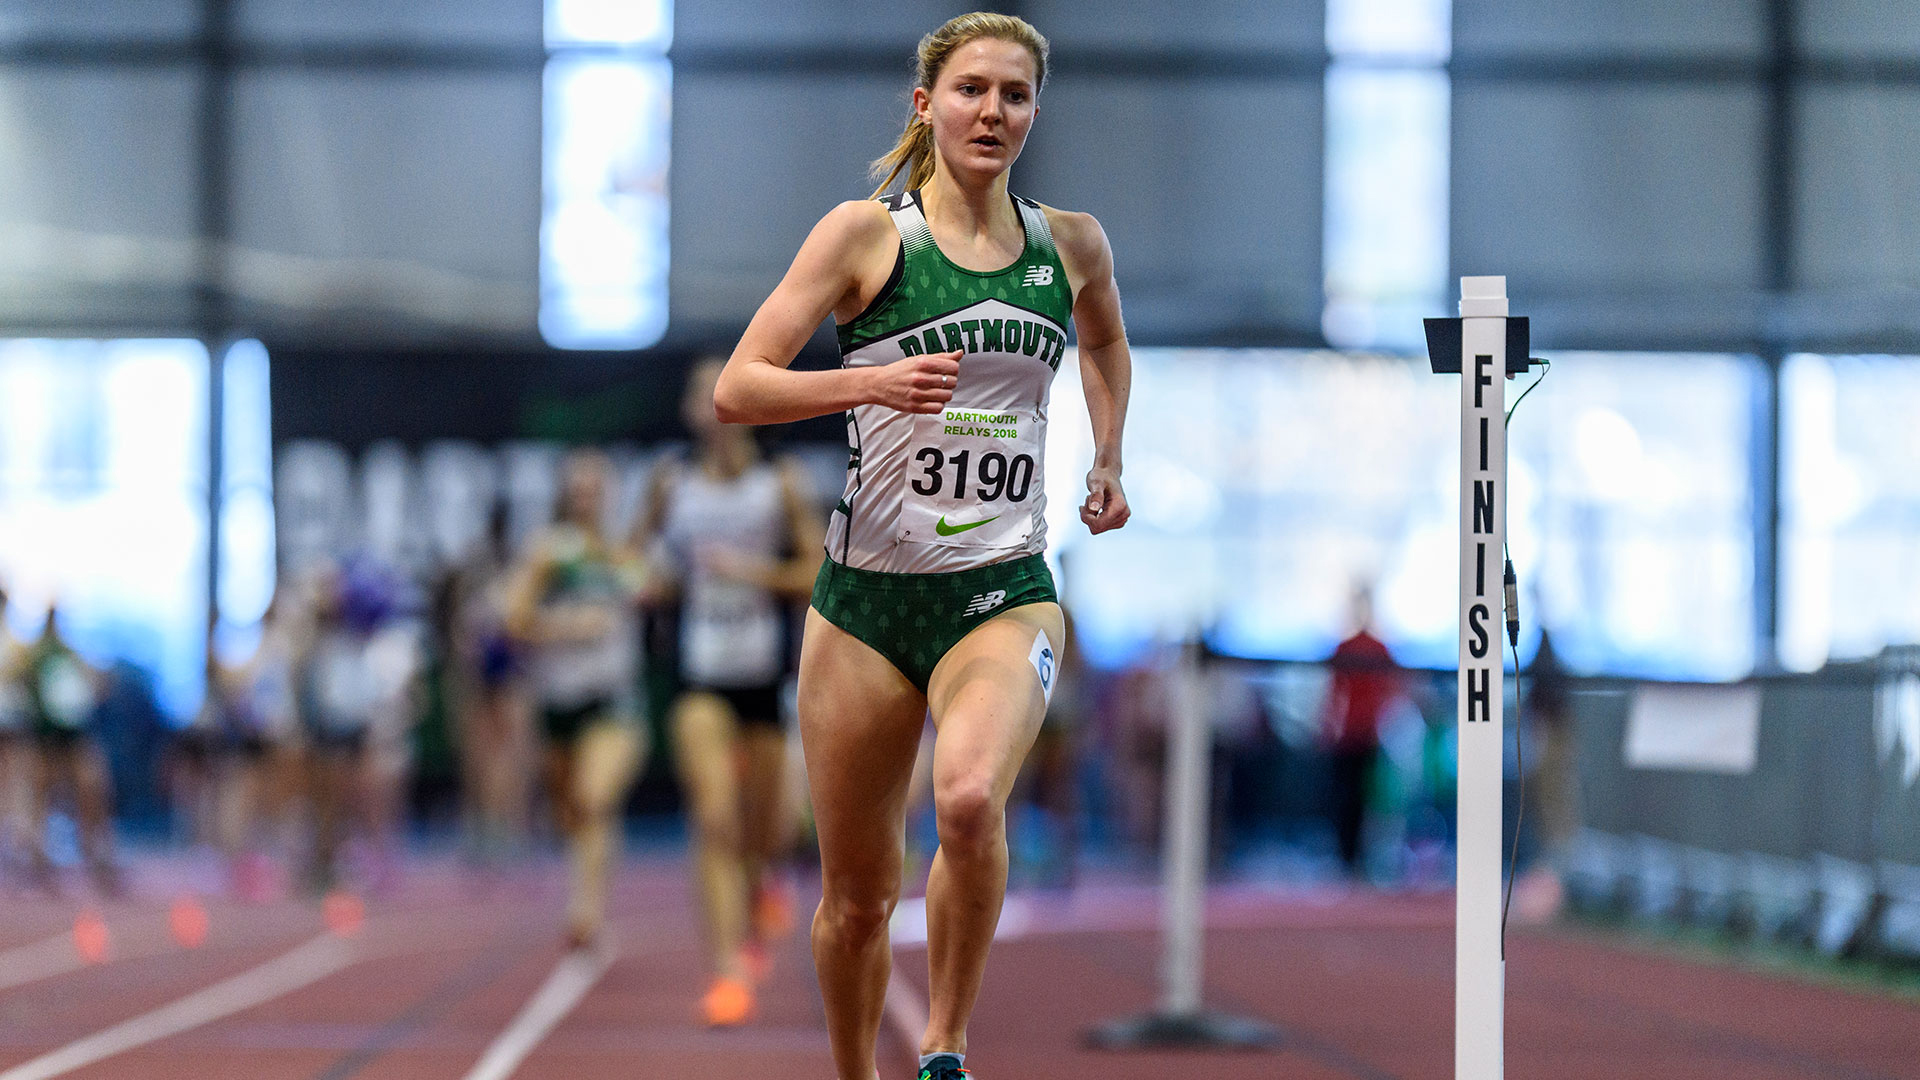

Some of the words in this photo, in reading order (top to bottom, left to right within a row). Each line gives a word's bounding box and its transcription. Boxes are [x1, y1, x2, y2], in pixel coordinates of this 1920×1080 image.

[898, 319, 1066, 372] DARTMOUTH
[944, 425, 991, 438] RELAYS
[993, 428, 1018, 439] 2018
[945, 411, 1018, 425] DARTMOUTH
[911, 447, 1034, 503] 3190
[1467, 354, 1495, 722] FINISH
